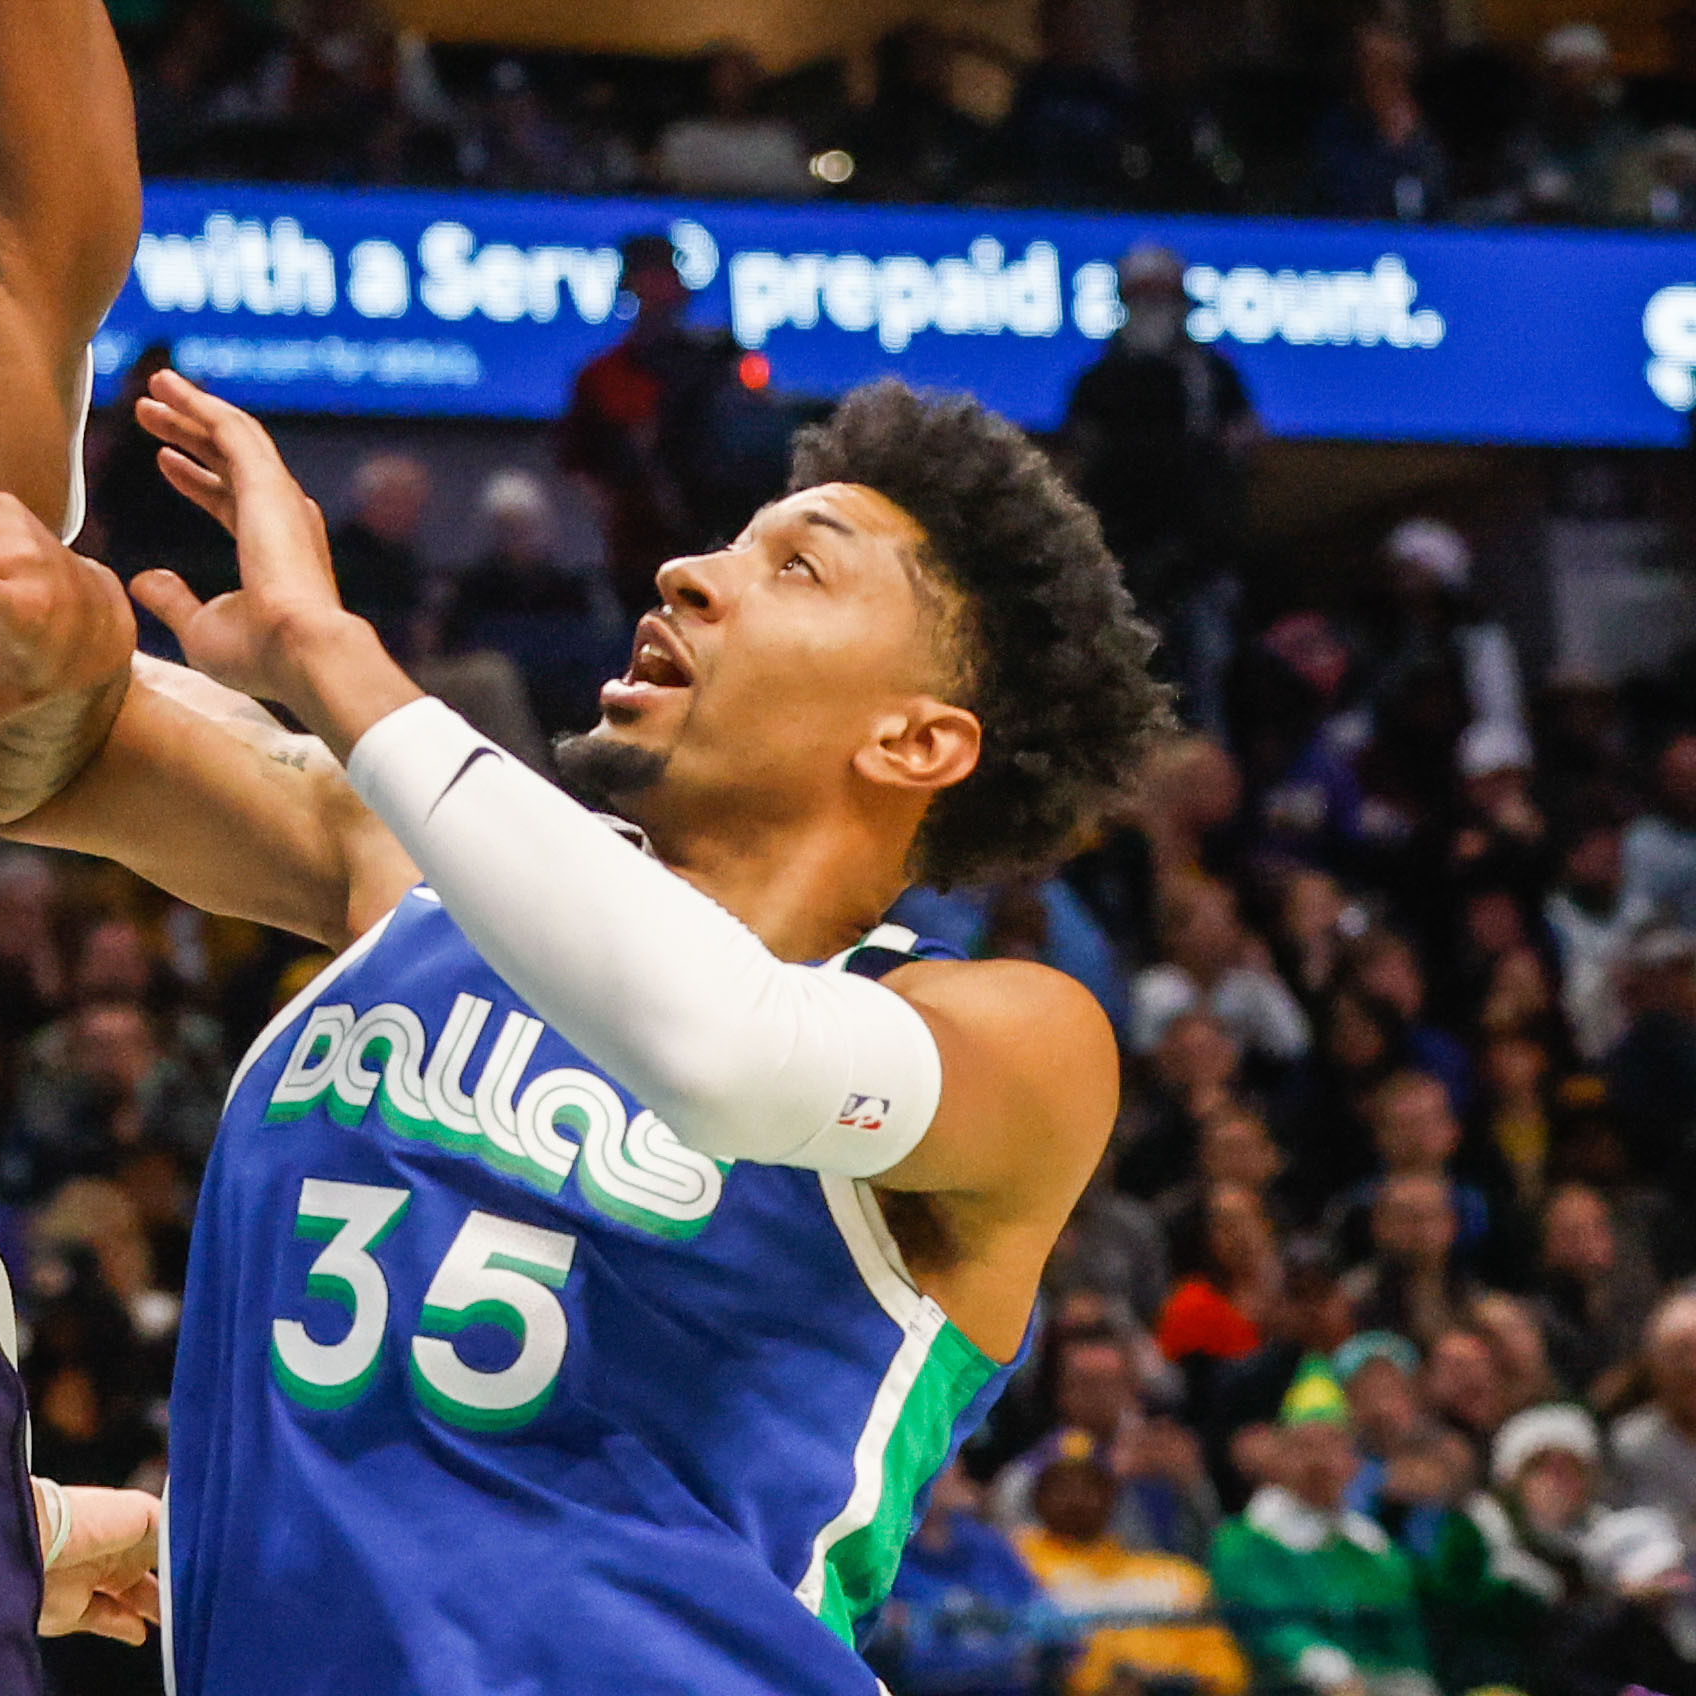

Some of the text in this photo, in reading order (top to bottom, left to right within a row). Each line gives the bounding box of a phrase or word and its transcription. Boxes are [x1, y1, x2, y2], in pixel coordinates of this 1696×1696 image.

[136, 211, 336, 315] with
[349, 240, 410, 318] a
[729, 235, 1062, 352] prepaid
[1072, 253, 1446, 350] acount.
[270, 1177, 577, 1432] 35
